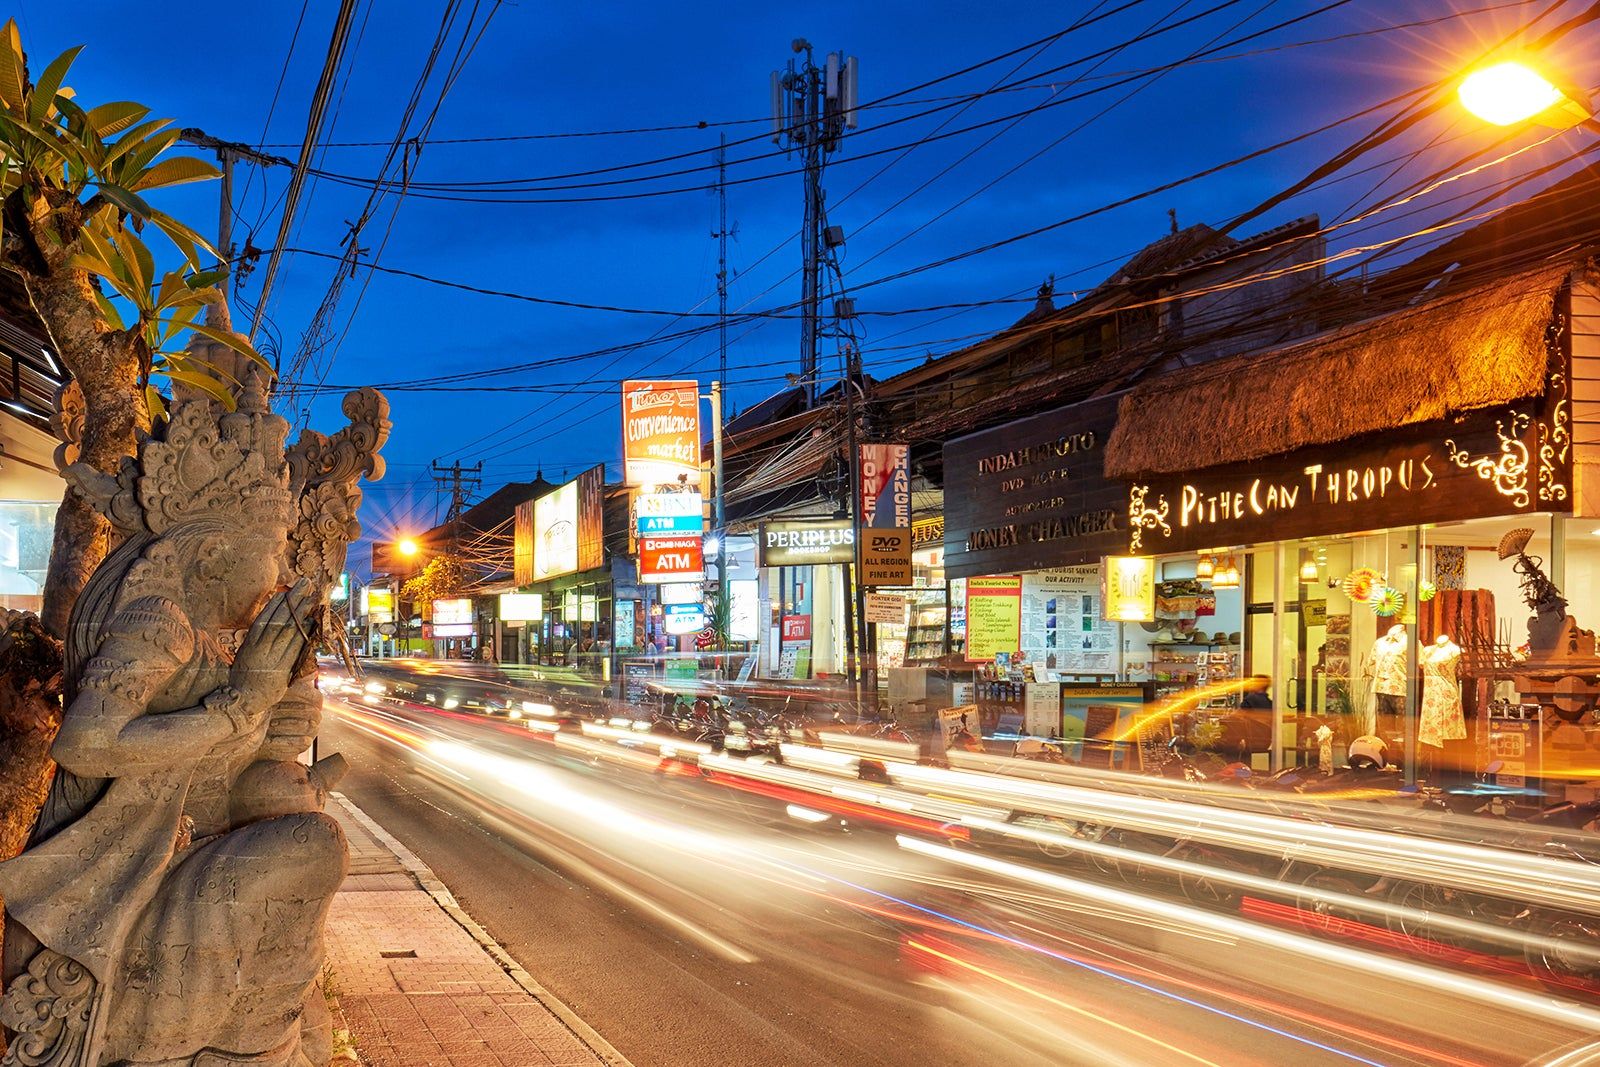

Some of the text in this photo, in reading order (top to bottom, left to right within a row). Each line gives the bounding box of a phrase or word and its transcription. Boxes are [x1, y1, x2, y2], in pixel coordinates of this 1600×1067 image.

[628, 408, 696, 442] convenience
[647, 437, 696, 462] market
[979, 447, 1031, 476] INDAH
[863, 445, 876, 527] MONEY
[894, 446, 909, 528] CHANGER
[1001, 478, 1024, 493] DVD
[647, 518, 675, 529] ATM
[965, 509, 1118, 552] MONEY CHANGER
[766, 529, 854, 547] PERIPLUS
[872, 537, 901, 546] DVD
[788, 546, 830, 555] BOOKSHOP
[656, 554, 690, 570] ATM
[865, 558, 909, 566] ALL REGION
[1075, 567, 1098, 575] SERVICE
[1058, 576, 1085, 584] ACTIVITY
[675, 616, 697, 624] ATM
